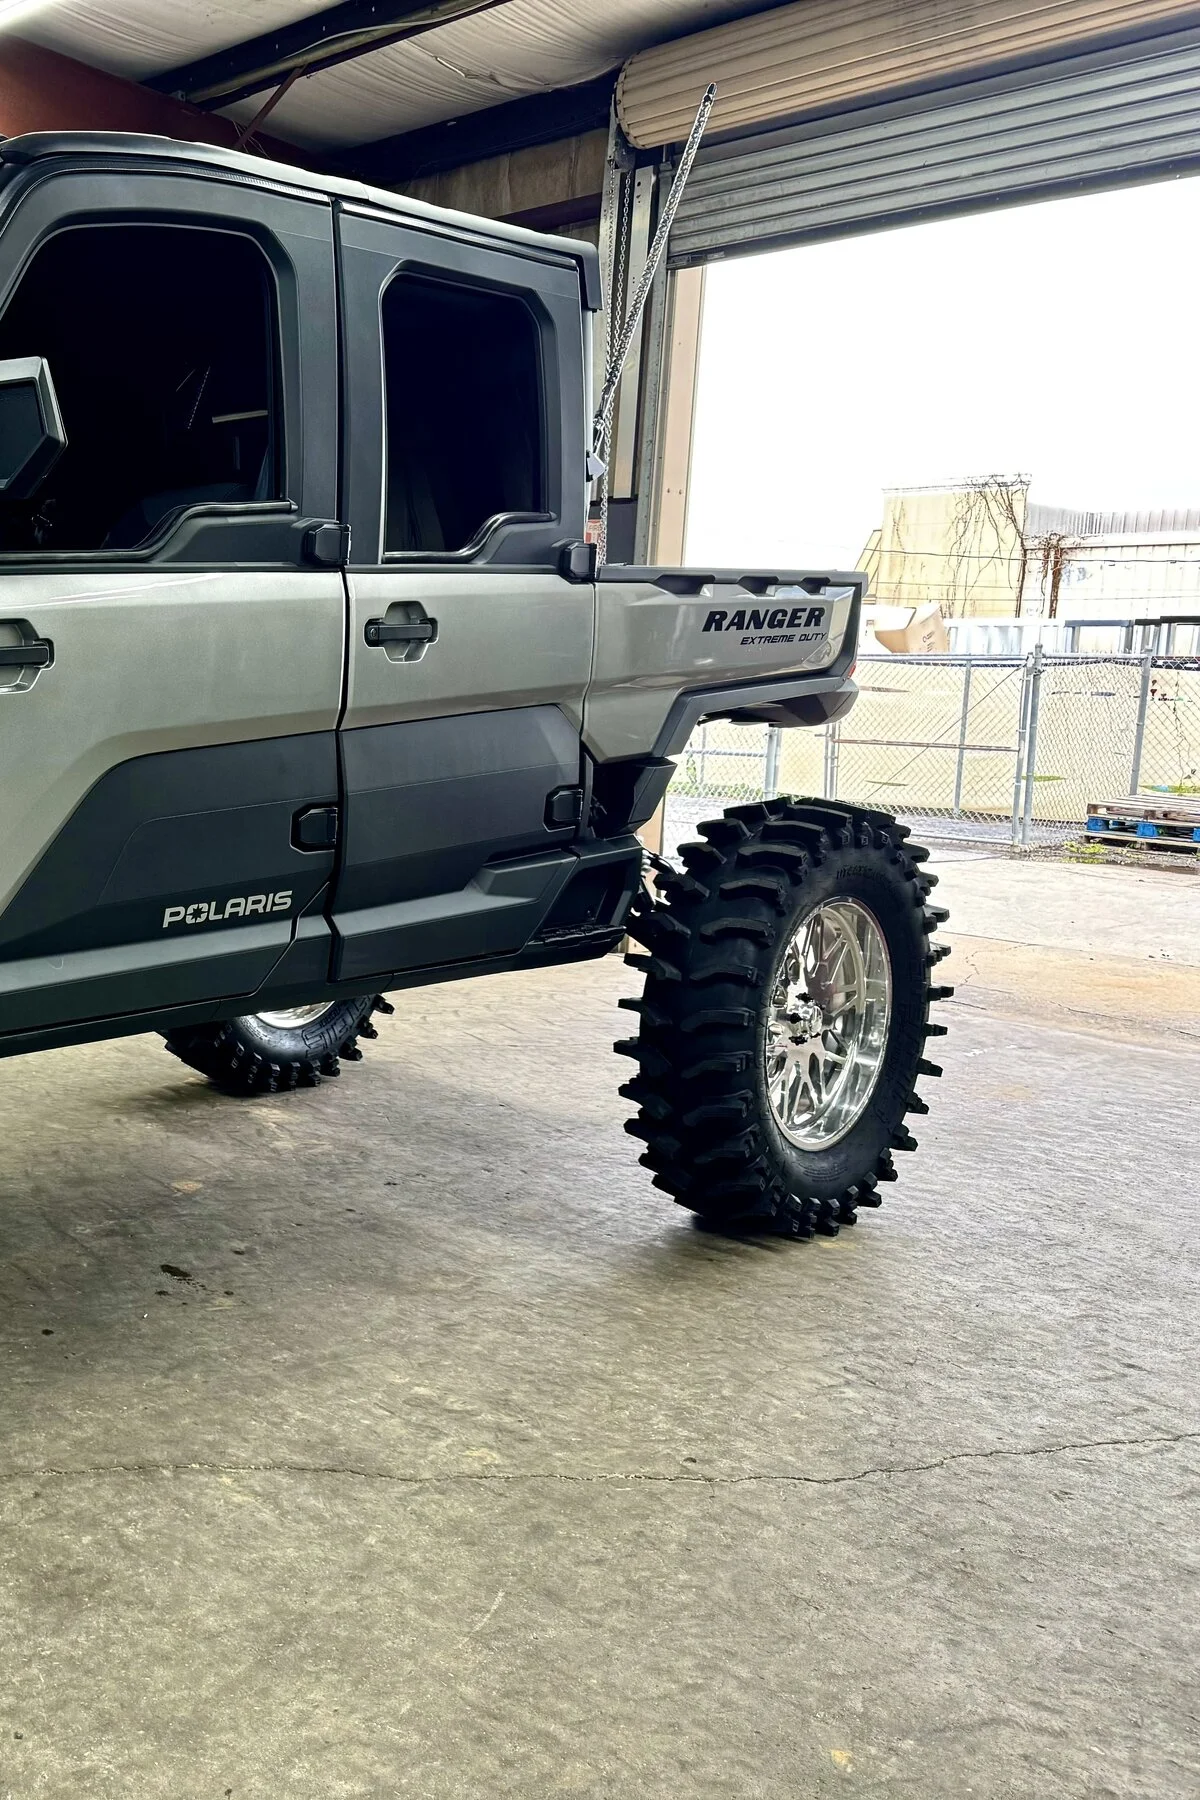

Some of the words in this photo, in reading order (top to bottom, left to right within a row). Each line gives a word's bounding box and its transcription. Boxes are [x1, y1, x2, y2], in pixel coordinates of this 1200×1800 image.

[702, 607, 826, 632] RANGER
[740, 634, 796, 645] EXTREME
[798, 632, 827, 642] DUTY
[162, 890, 293, 928] POLARIS
